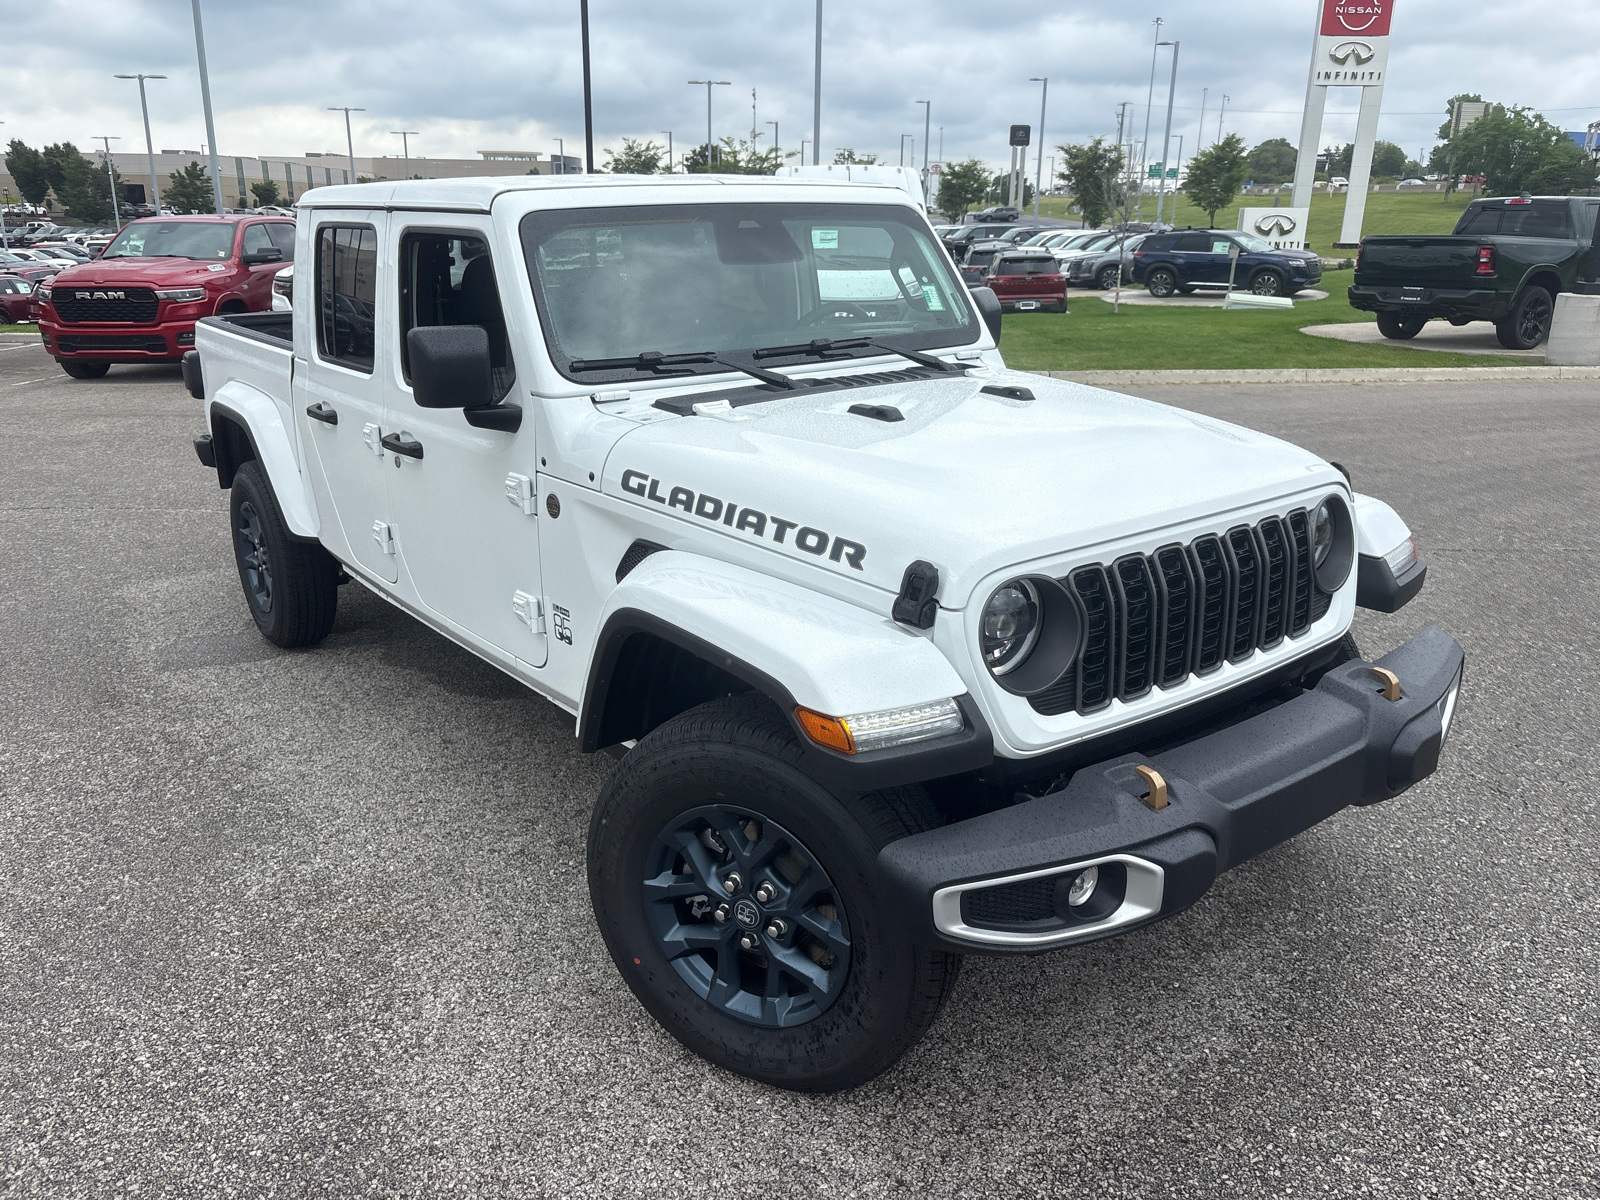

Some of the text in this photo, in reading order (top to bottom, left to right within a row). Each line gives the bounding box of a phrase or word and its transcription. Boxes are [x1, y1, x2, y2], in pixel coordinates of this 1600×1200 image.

[1335, 6, 1382, 14] NISSAN
[1316, 71, 1382, 80] INFINITI
[1391, 253, 1442, 262] RAM
[74, 291, 126, 300] RAM
[620, 468, 867, 572] GLADIATOR
[737, 904, 756, 925] 85
